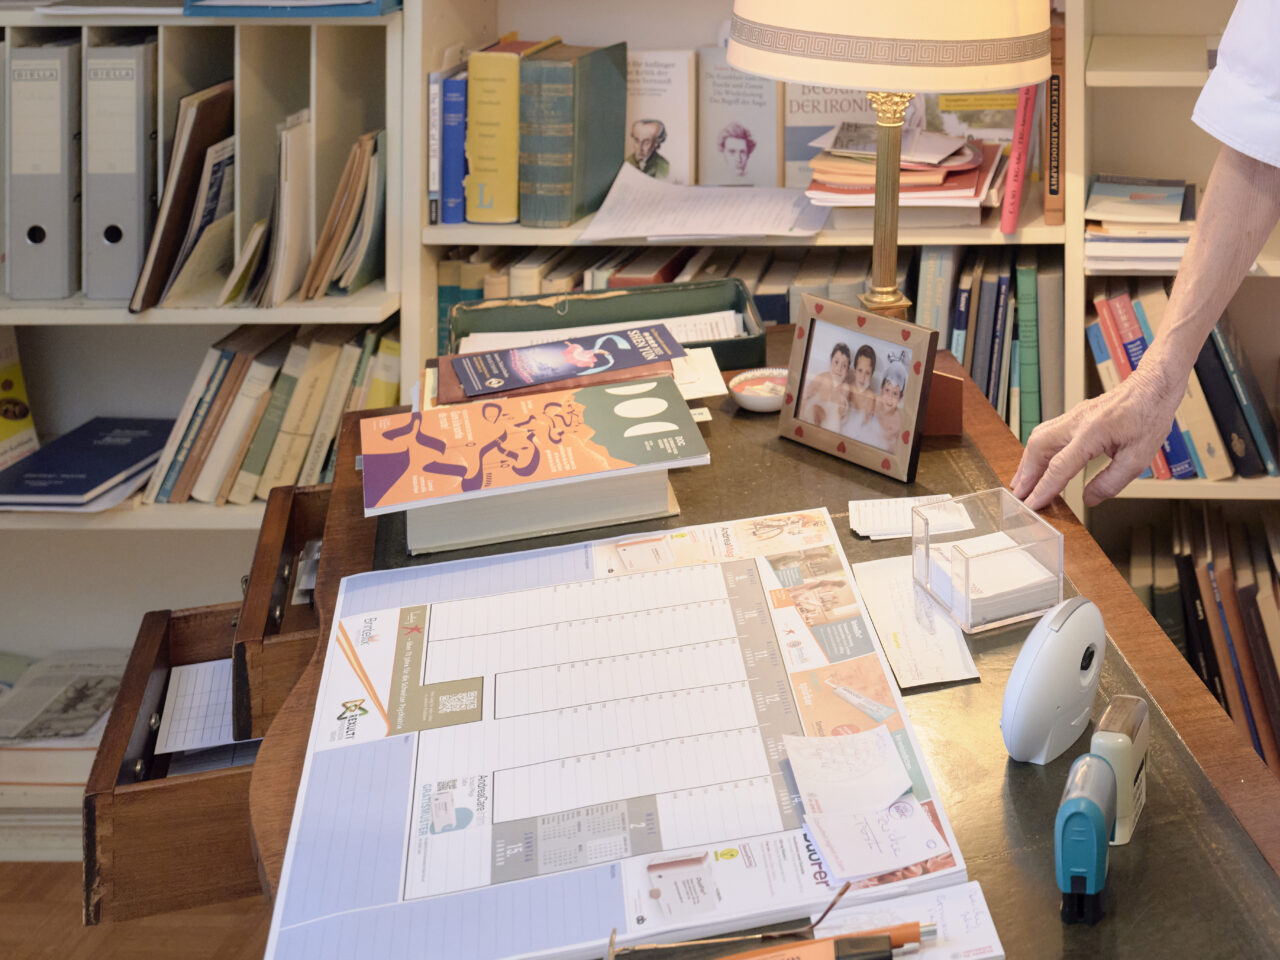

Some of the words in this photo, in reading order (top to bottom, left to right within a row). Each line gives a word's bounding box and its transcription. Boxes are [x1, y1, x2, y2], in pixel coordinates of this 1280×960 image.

[16, 69, 56, 80] BIELLA
[91, 69, 132, 79] BIELLA
[789, 97, 823, 114] DER
[1050, 78, 1060, 192] ELECTROCARDIOGRAPHY
